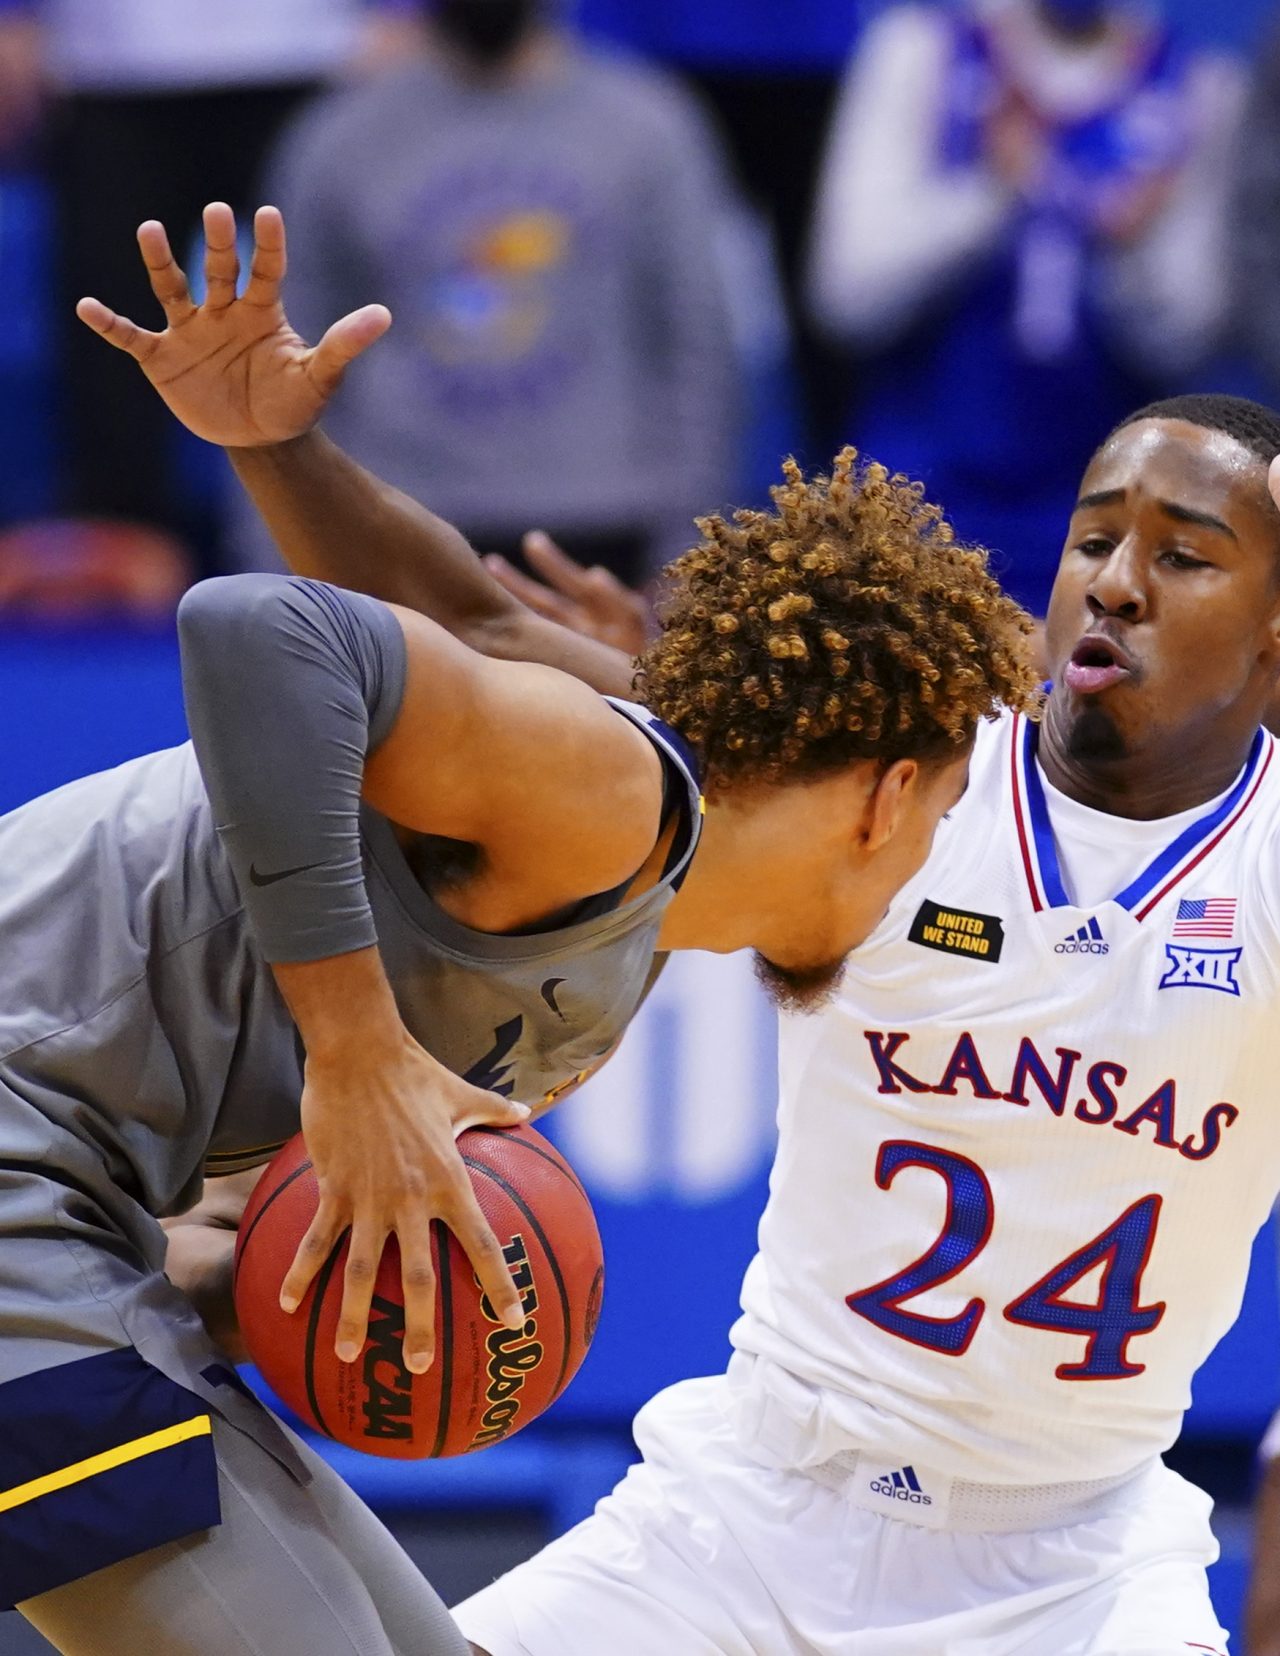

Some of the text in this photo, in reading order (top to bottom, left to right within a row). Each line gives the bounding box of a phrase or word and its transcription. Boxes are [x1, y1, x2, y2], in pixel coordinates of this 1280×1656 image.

[936, 911, 985, 935] UNITED
[922, 924, 991, 955] WE STAND
[1054, 939, 1110, 956] adidas
[864, 1030, 1239, 1160] KANSAS
[845, 1139, 1166, 1381] 24
[869, 1479, 933, 1506] adidas
